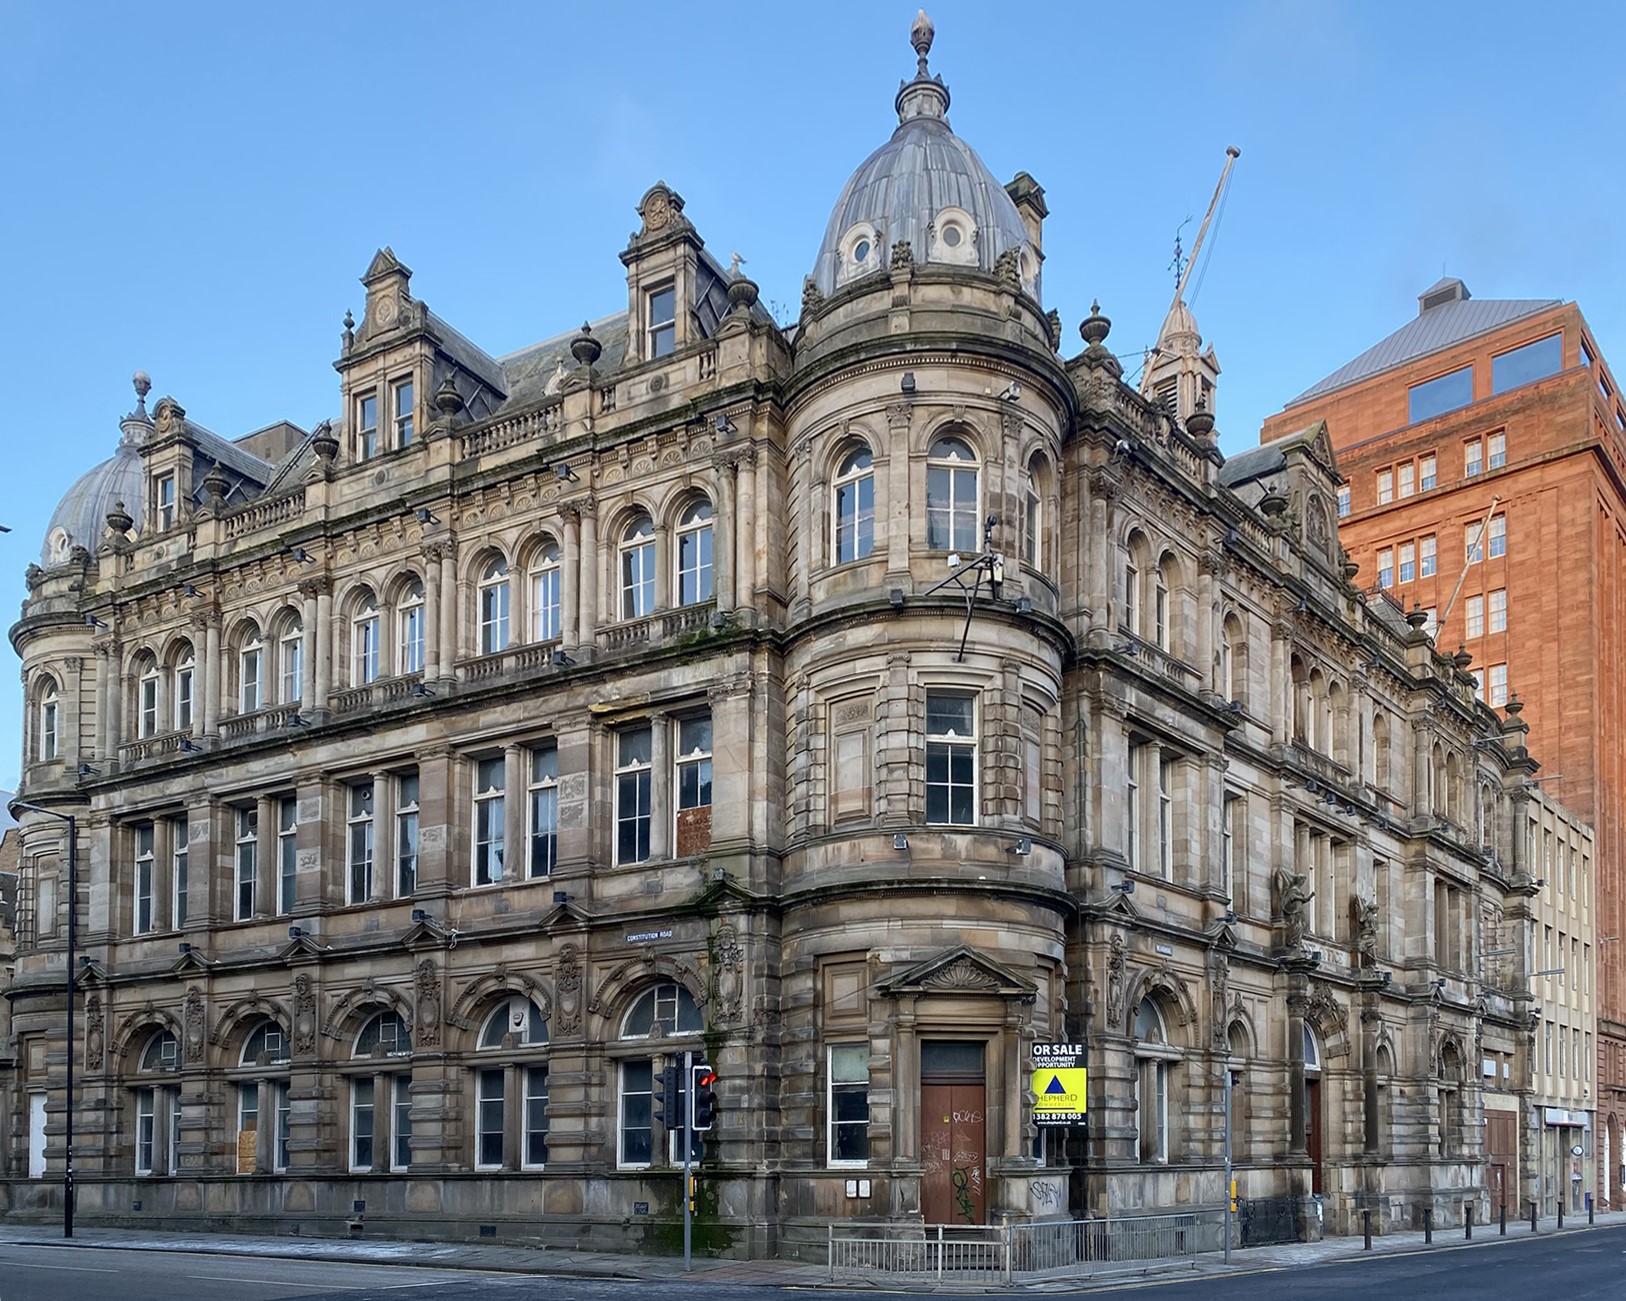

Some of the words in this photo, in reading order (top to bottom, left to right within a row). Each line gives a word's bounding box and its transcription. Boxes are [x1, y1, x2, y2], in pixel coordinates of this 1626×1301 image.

[627, 932, 658, 942] CONSTITUTION
[1034, 1044, 1050, 1055] OR
[1052, 1044, 1082, 1055] SALE
[1038, 1094, 1078, 1102] HEPHERD
